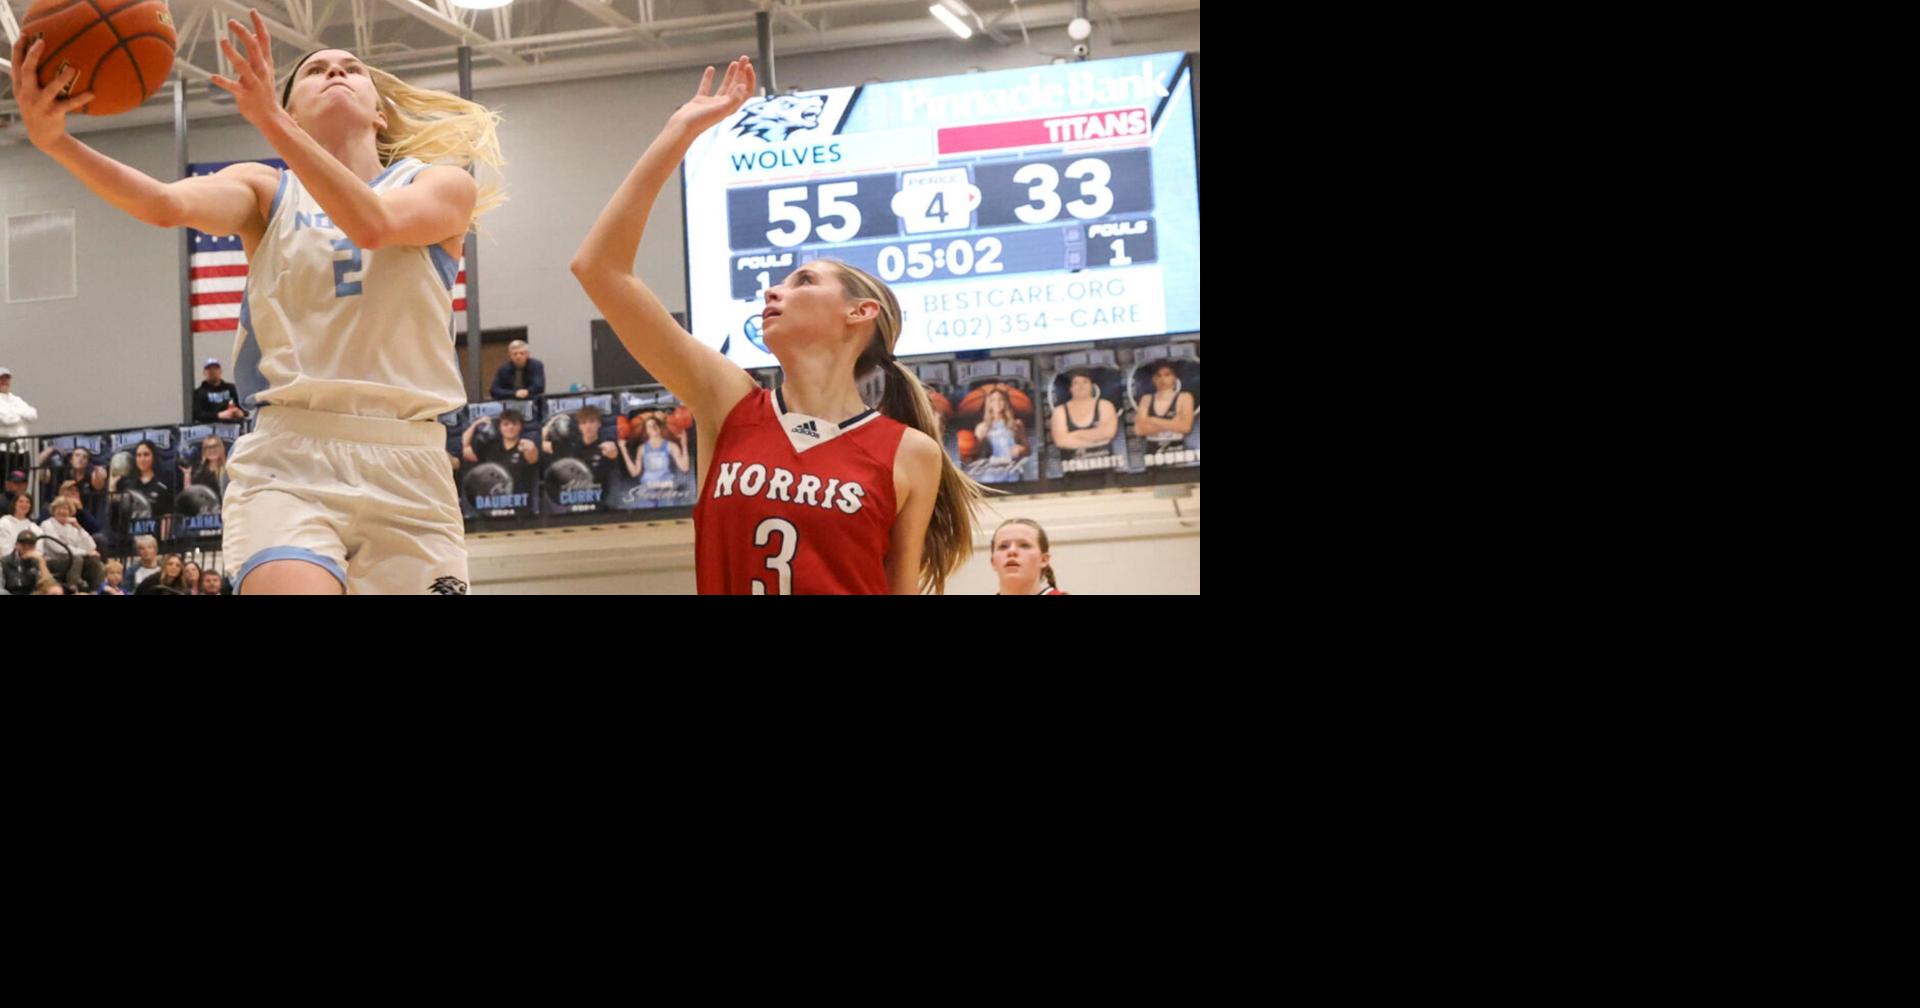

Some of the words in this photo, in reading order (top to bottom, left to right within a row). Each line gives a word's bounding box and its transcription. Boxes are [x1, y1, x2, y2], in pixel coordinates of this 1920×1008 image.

[901, 72, 1065, 122] Pinnacle
[1067, 60, 1168, 105] Bank
[1043, 111, 1147, 143] TITANS
[731, 143, 842, 172] WOLVES
[925, 191, 950, 224] 4
[1012, 158, 1115, 224] 33
[766, 181, 862, 248] 55
[1088, 220, 1149, 239] FOULS
[330, 238, 363, 298] 2
[737, 253, 793, 270] FOULS
[876, 236, 1004, 282] 05:02
[1109, 239, 1132, 266] 1
[755, 271, 771, 298] 1
[923, 277, 1126, 314] BESTCARE.ORG
[926, 314, 993, 342] (402)
[1000, 303, 1142, 335] 354-CARE
[475, 493, 529, 509] DAUBERT
[560, 489, 602, 504] CURRY
[713, 461, 866, 515] NORRIS
[750, 516, 800, 595] 3
